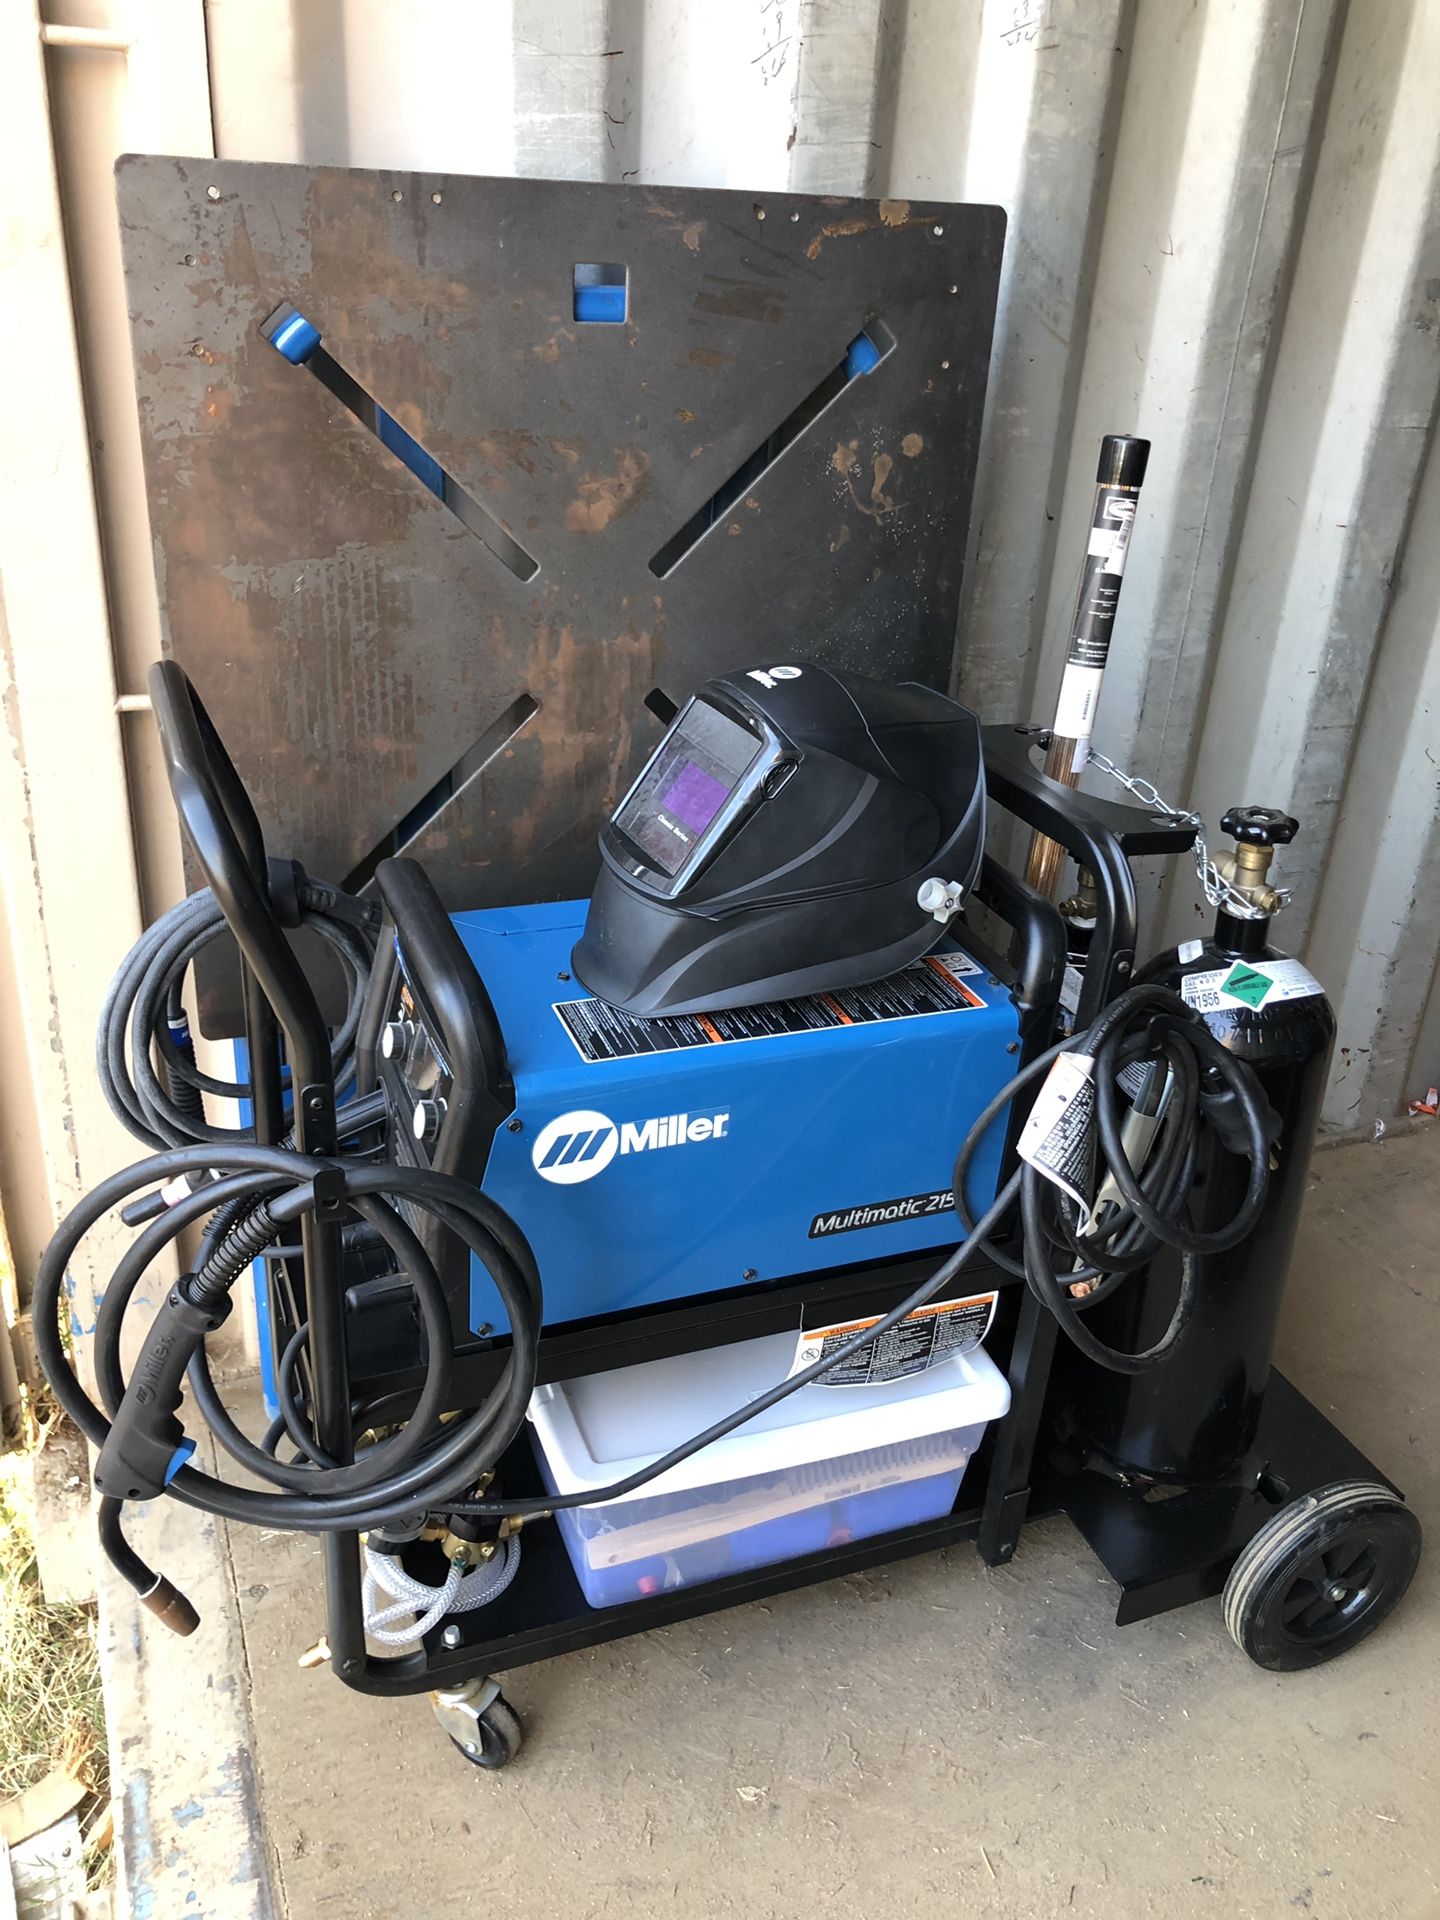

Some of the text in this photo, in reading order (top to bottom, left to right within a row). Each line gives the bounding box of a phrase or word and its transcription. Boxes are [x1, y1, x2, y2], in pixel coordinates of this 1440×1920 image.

[1250, 995, 1257, 1003] 2
[620, 1112, 729, 1155] Miller
[813, 1192, 955, 1234] Multimatic 215
[142, 1336, 177, 1398] Miller
